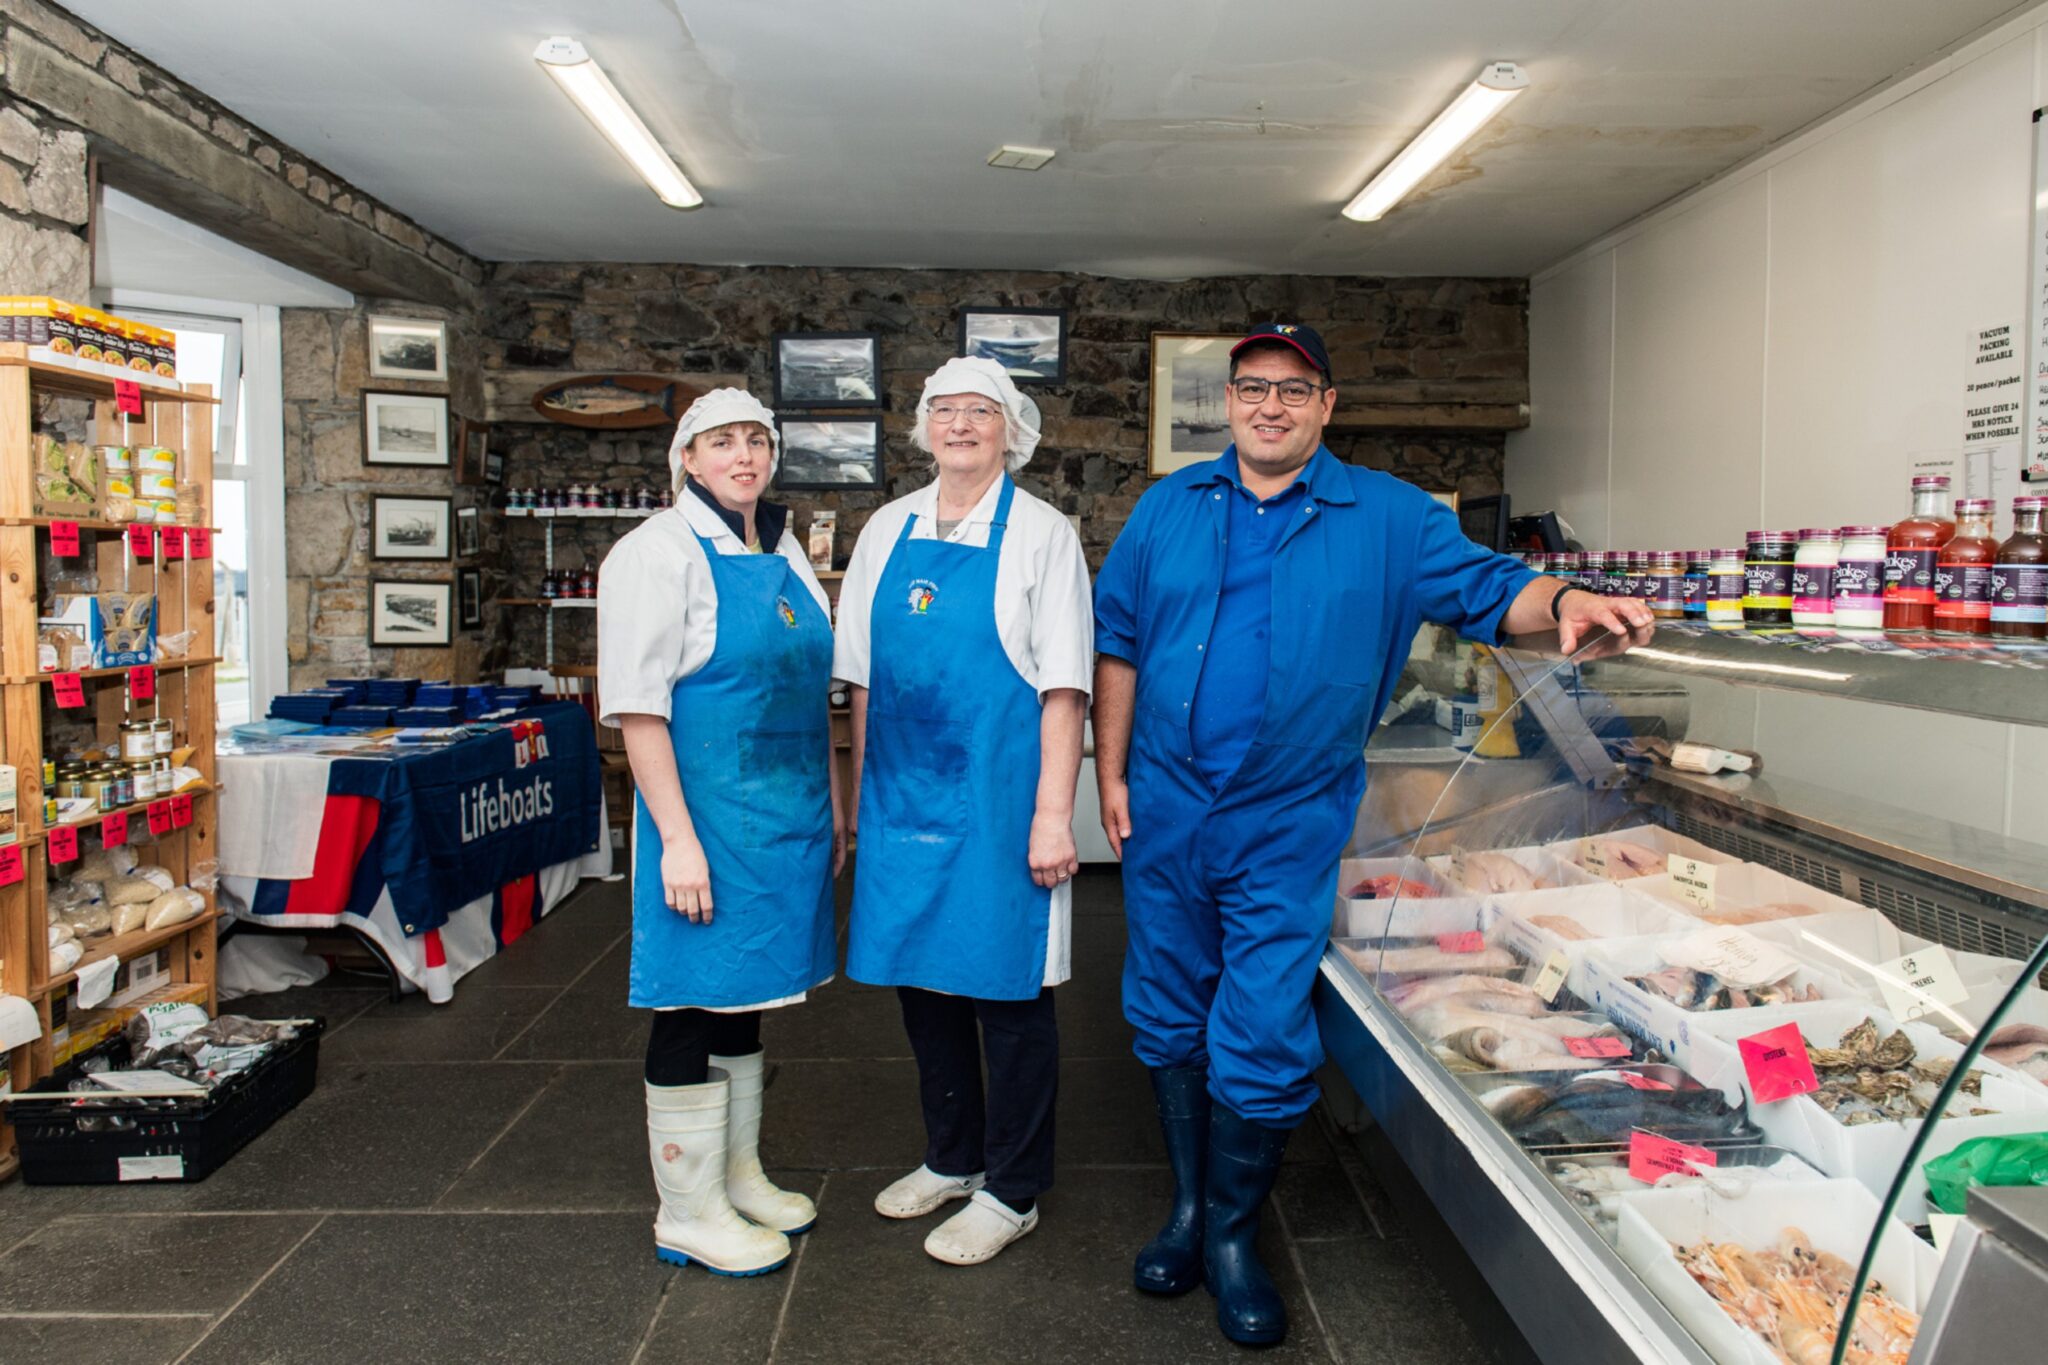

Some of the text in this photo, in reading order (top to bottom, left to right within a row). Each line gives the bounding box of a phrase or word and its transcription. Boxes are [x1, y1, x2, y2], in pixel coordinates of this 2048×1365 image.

[1979, 325, 2010, 340] VACUUM
[1979, 338, 2010, 352] PACKING
[1976, 349, 2014, 365] AVAILABLE
[1966, 406, 1991, 418] PLEASE
[1992, 403, 2010, 414] GIVE
[1972, 415, 2013, 429] HRS NOTICE
[1965, 426, 2020, 441] WHEN POSSIBLE
[461, 775, 553, 843] Lifeboats
